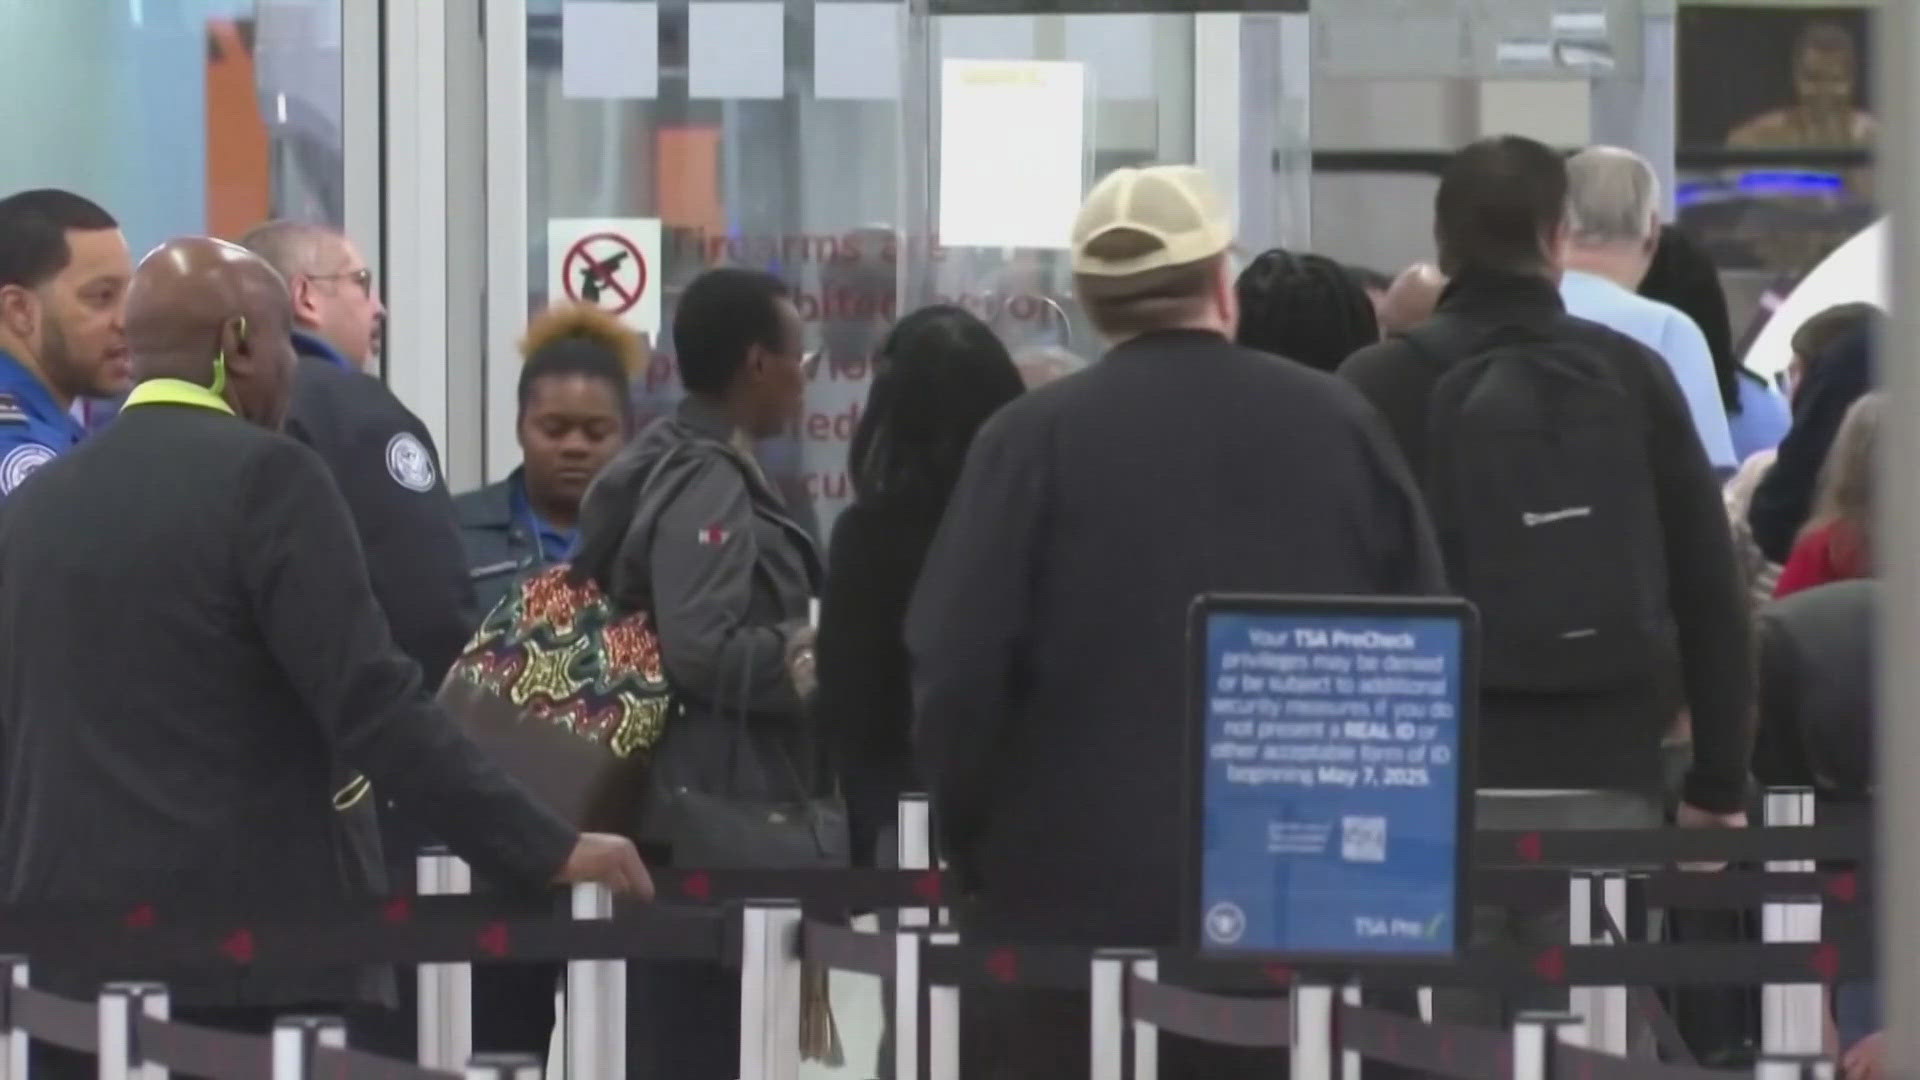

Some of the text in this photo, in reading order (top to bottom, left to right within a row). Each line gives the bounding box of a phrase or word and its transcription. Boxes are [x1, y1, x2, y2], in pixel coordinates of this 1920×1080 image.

[672, 226, 862, 264] Firearms
[1248, 629, 1415, 650] Your TSA PreCheck
[1222, 653, 1444, 674] privileges may be denied
[1217, 674, 1446, 696] or be subject to additional
[1211, 698, 1280, 718] security
[1285, 700, 1370, 716] measures
[1393, 703, 1427, 722] you
[1430, 701, 1454, 719] do
[1223, 720, 1254, 736] not
[1257, 721, 1324, 740] present
[1344, 722, 1391, 740] REAL
[1395, 722, 1416, 741] ID
[1418, 725, 1438, 741] or
[1210, 743, 1258, 760] other
[1263, 744, 1356, 762] acceptable
[1360, 745, 1404, 763] form
[1407, 744, 1427, 763] of
[1226, 765, 1314, 787] beginning
[1318, 766, 1358, 788] May
[1363, 766, 1379, 787] 7,
[1354, 916, 1424, 939] TSA Pre
